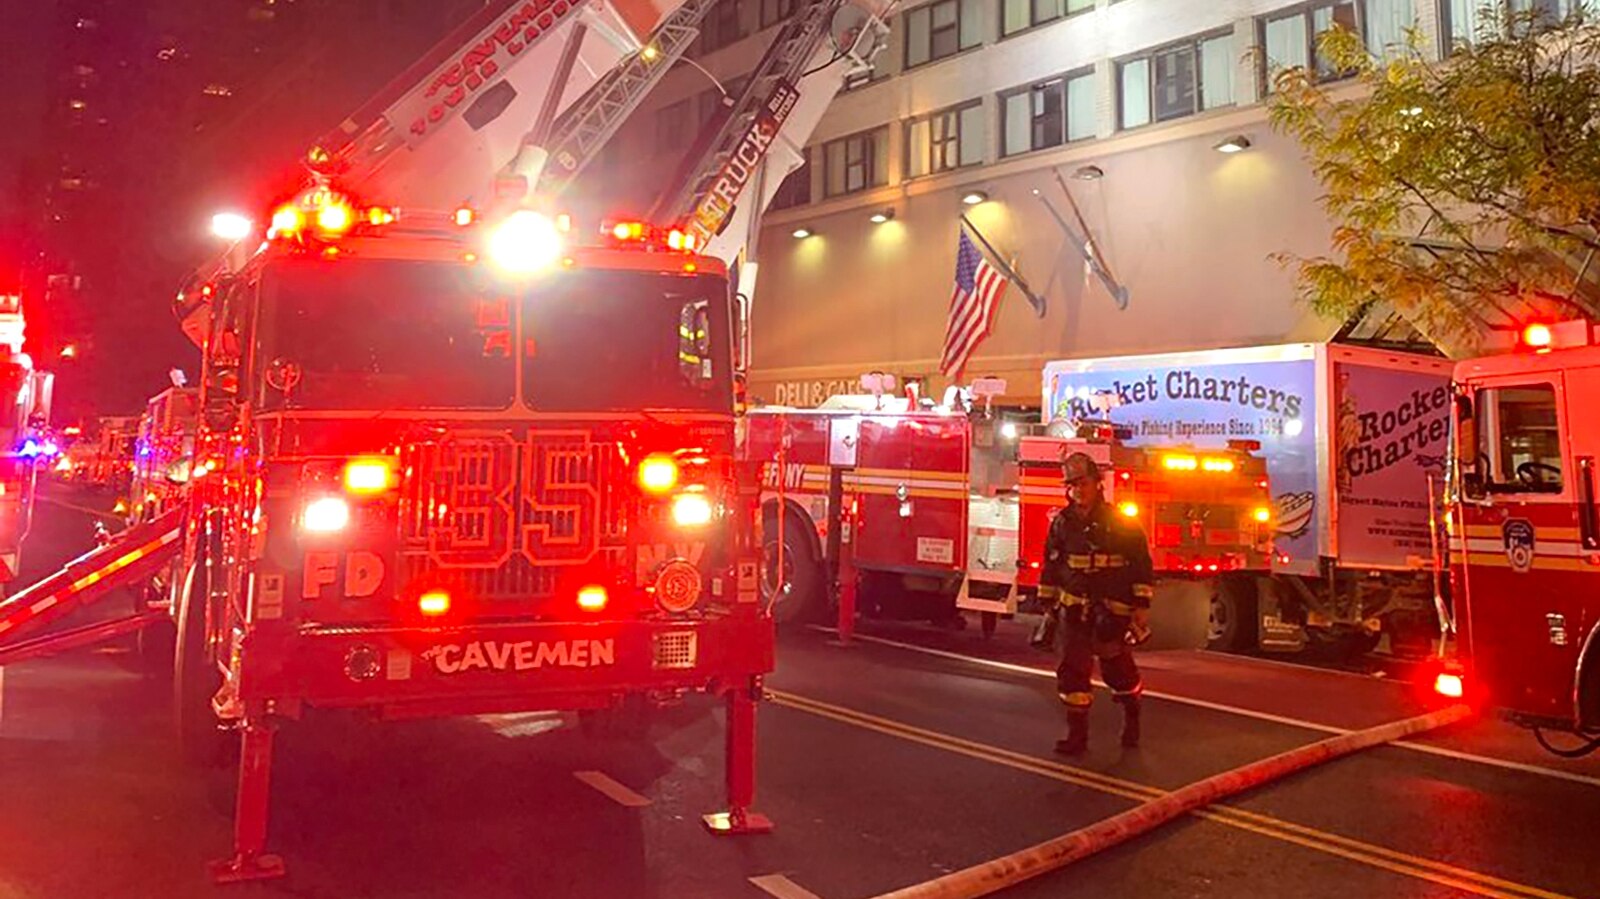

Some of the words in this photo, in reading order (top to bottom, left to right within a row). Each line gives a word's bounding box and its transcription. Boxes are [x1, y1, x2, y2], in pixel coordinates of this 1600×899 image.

[703, 124, 771, 217] TRUCK
[775, 381, 809, 407] DELI
[813, 381, 823, 406] &
[1067, 374, 1158, 418] Roket
[1166, 370, 1302, 420] Charters
[1176, 419, 1227, 439] Experience
[1229, 418, 1255, 435] Since
[428, 428, 602, 569] 35
[302, 550, 386, 599] FD
[435, 638, 615, 674] CAVEMEN
